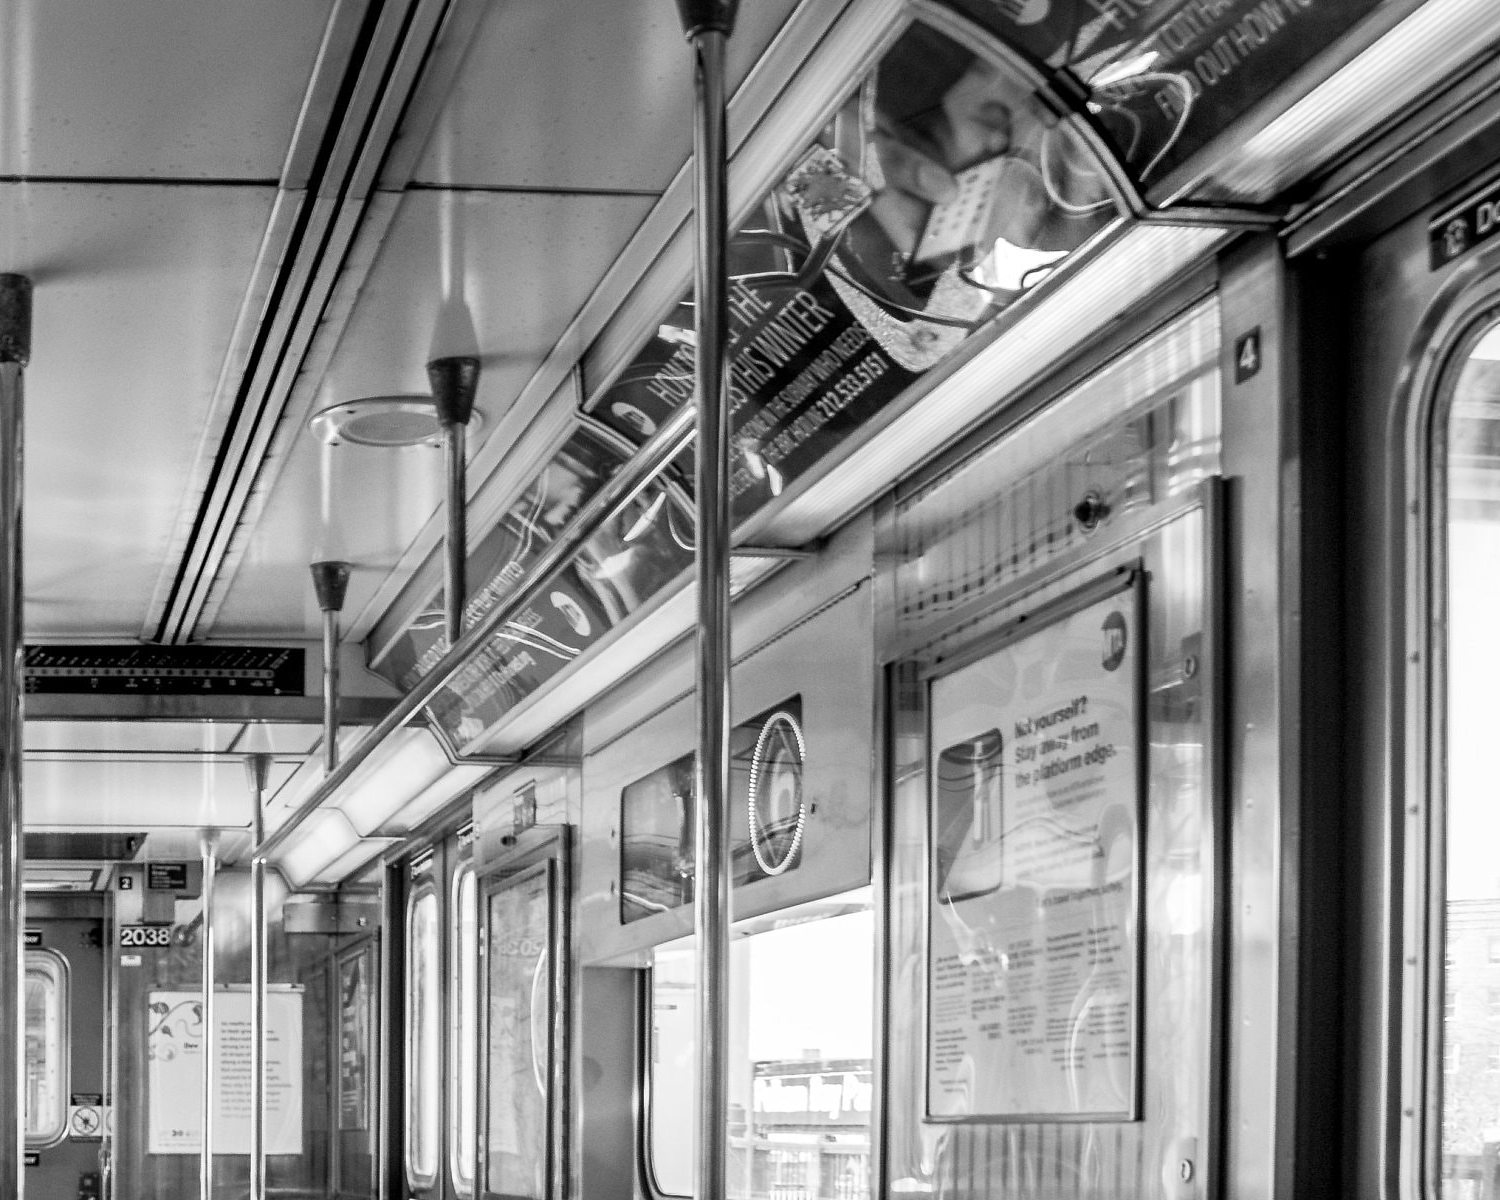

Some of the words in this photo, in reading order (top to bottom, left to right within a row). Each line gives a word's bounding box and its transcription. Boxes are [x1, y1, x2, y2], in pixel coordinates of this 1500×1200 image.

[1194, 35, 1241, 86] OUT
[727, 278, 773, 328] THE
[750, 290, 836, 369] WINTER
[808, 349, 843, 381] WHO
[829, 320, 872, 361] NEEDS
[1239, 336, 1257, 369] 4
[728, 346, 777, 395] THIS
[815, 351, 890, 418] 212.533.5151
[1071, 722, 1099, 743] from
[1033, 754, 1082, 783] platform
[121, 877, 131, 889] 2
[120, 929, 171, 946] 2038
